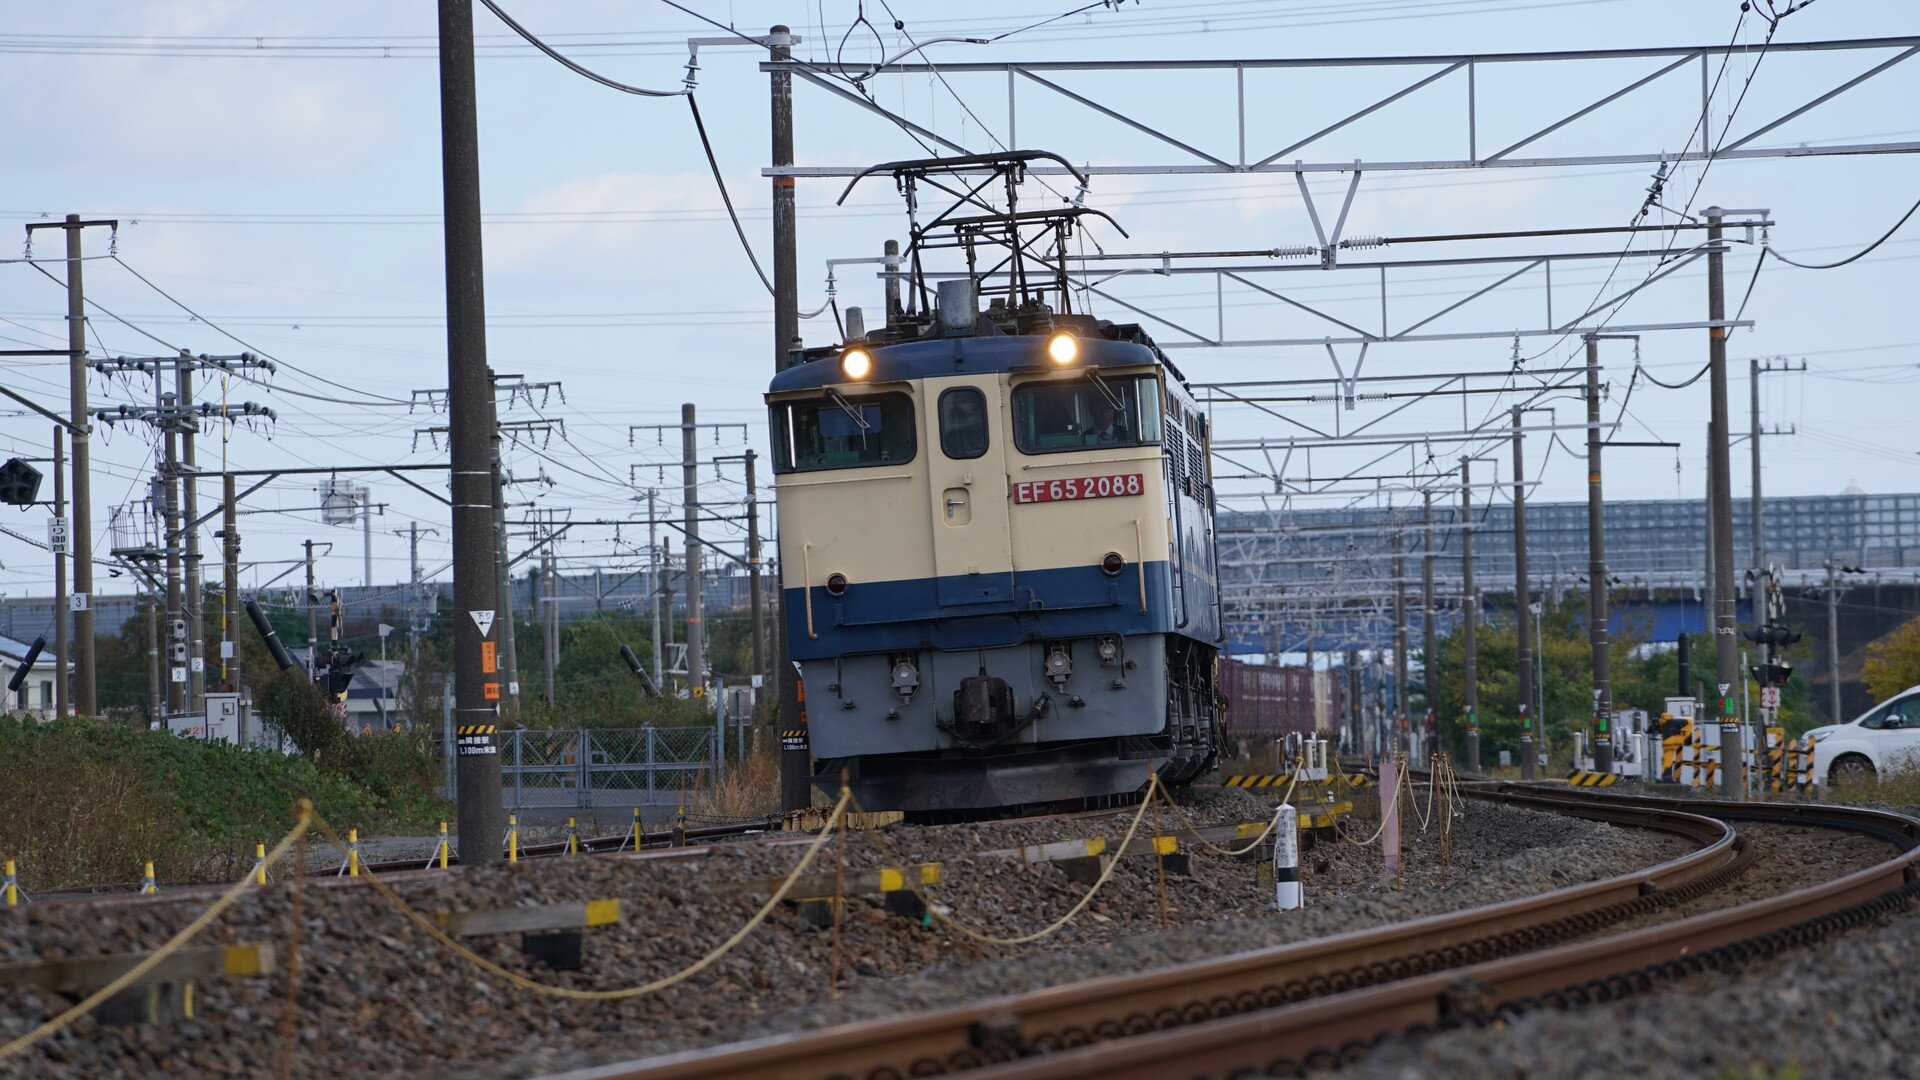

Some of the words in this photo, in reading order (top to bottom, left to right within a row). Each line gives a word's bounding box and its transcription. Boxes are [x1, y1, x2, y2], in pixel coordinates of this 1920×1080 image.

[1083, 475, 1140, 498] 2088
[75, 596, 82, 608] 3
[476, 611, 491, 620] 下り
